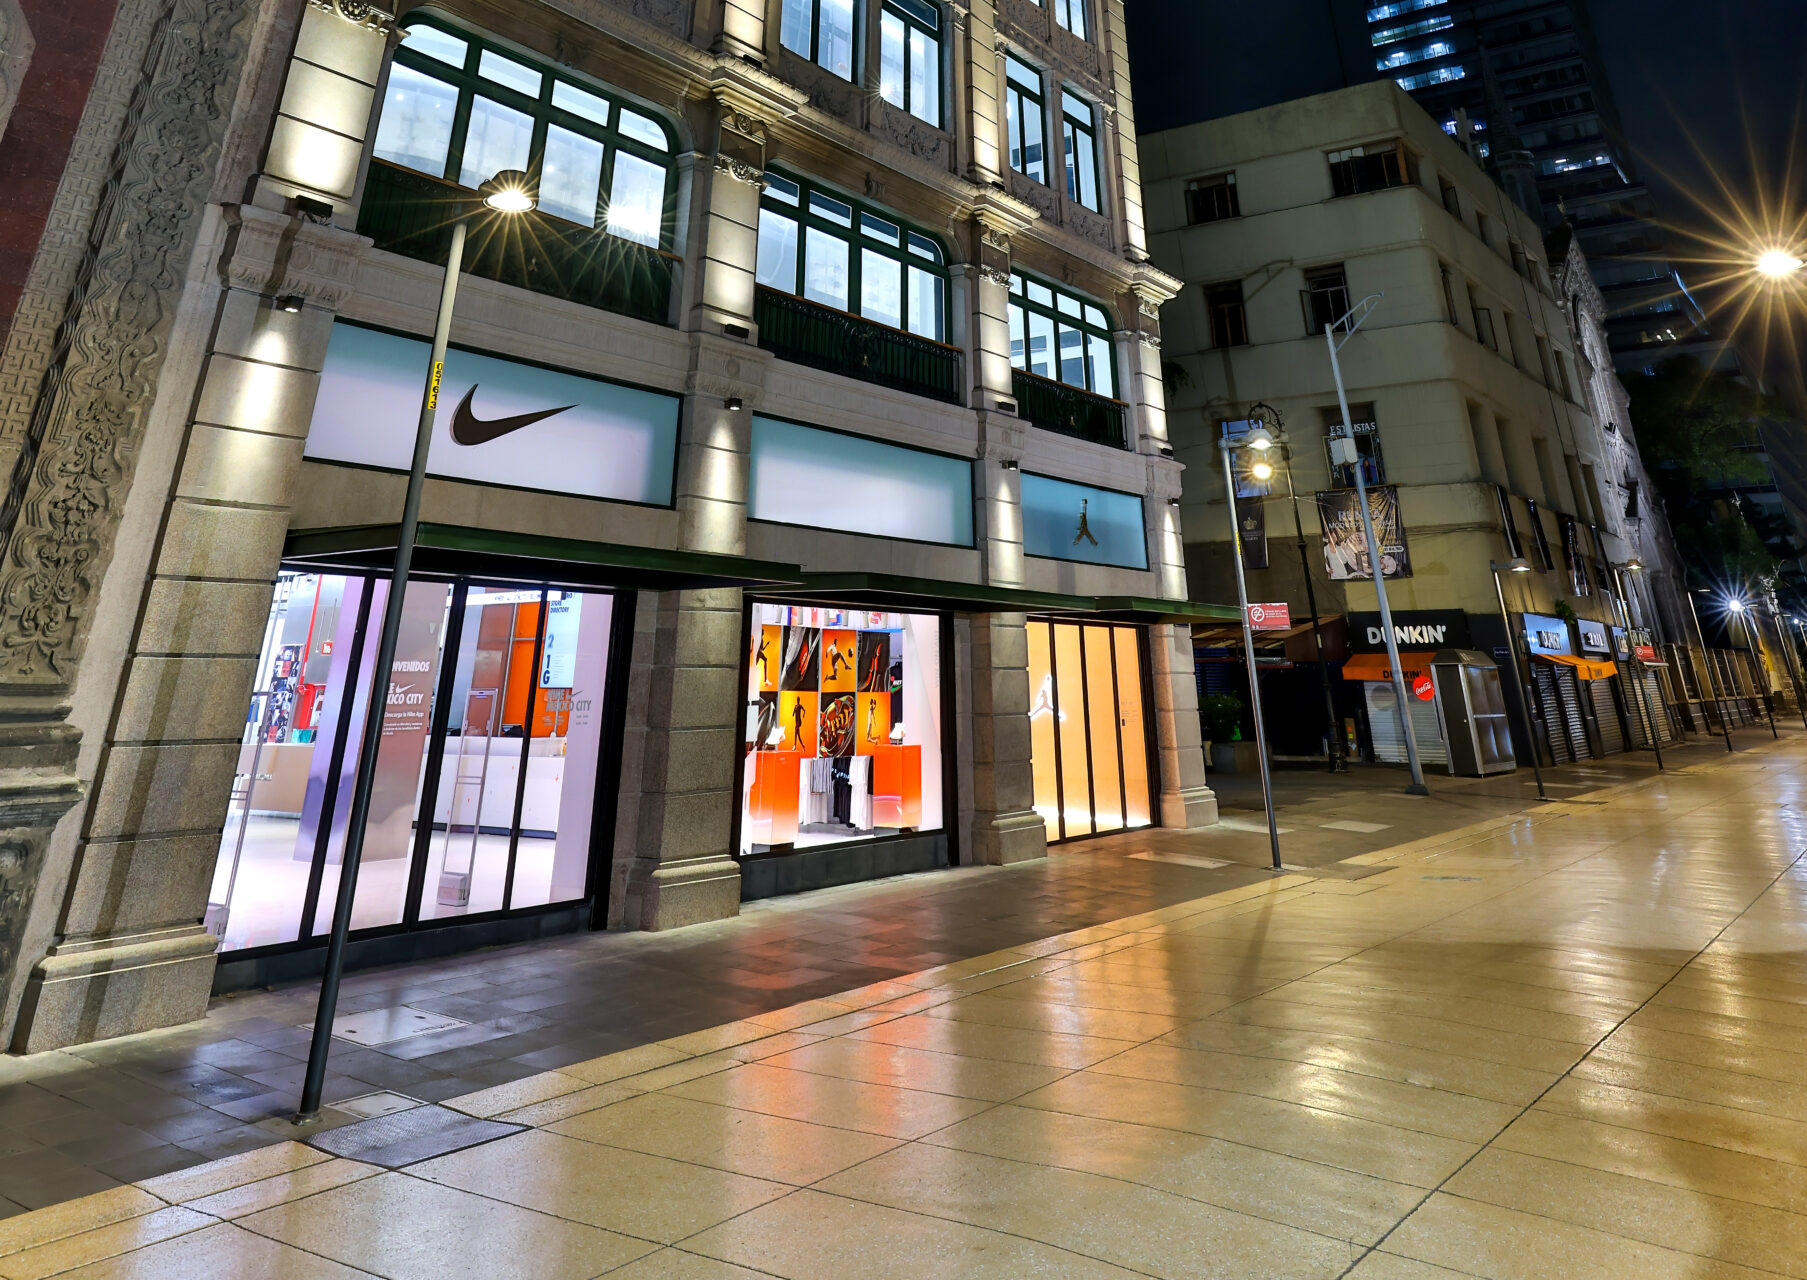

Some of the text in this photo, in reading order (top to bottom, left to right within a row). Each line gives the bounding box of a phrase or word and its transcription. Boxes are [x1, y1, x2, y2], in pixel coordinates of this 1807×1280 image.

[430, 362, 443, 409] 051613
[1330, 421, 1376, 433] ESTISTAS
[1337, 508, 1381, 521] RENA
[391, 661, 430, 672] NVENIDOS
[542, 670, 550, 685] G
[1382, 670, 1422, 679] DKIN'
[387, 693, 424, 705] XICO CITY
[576, 700, 591, 712] CITY
